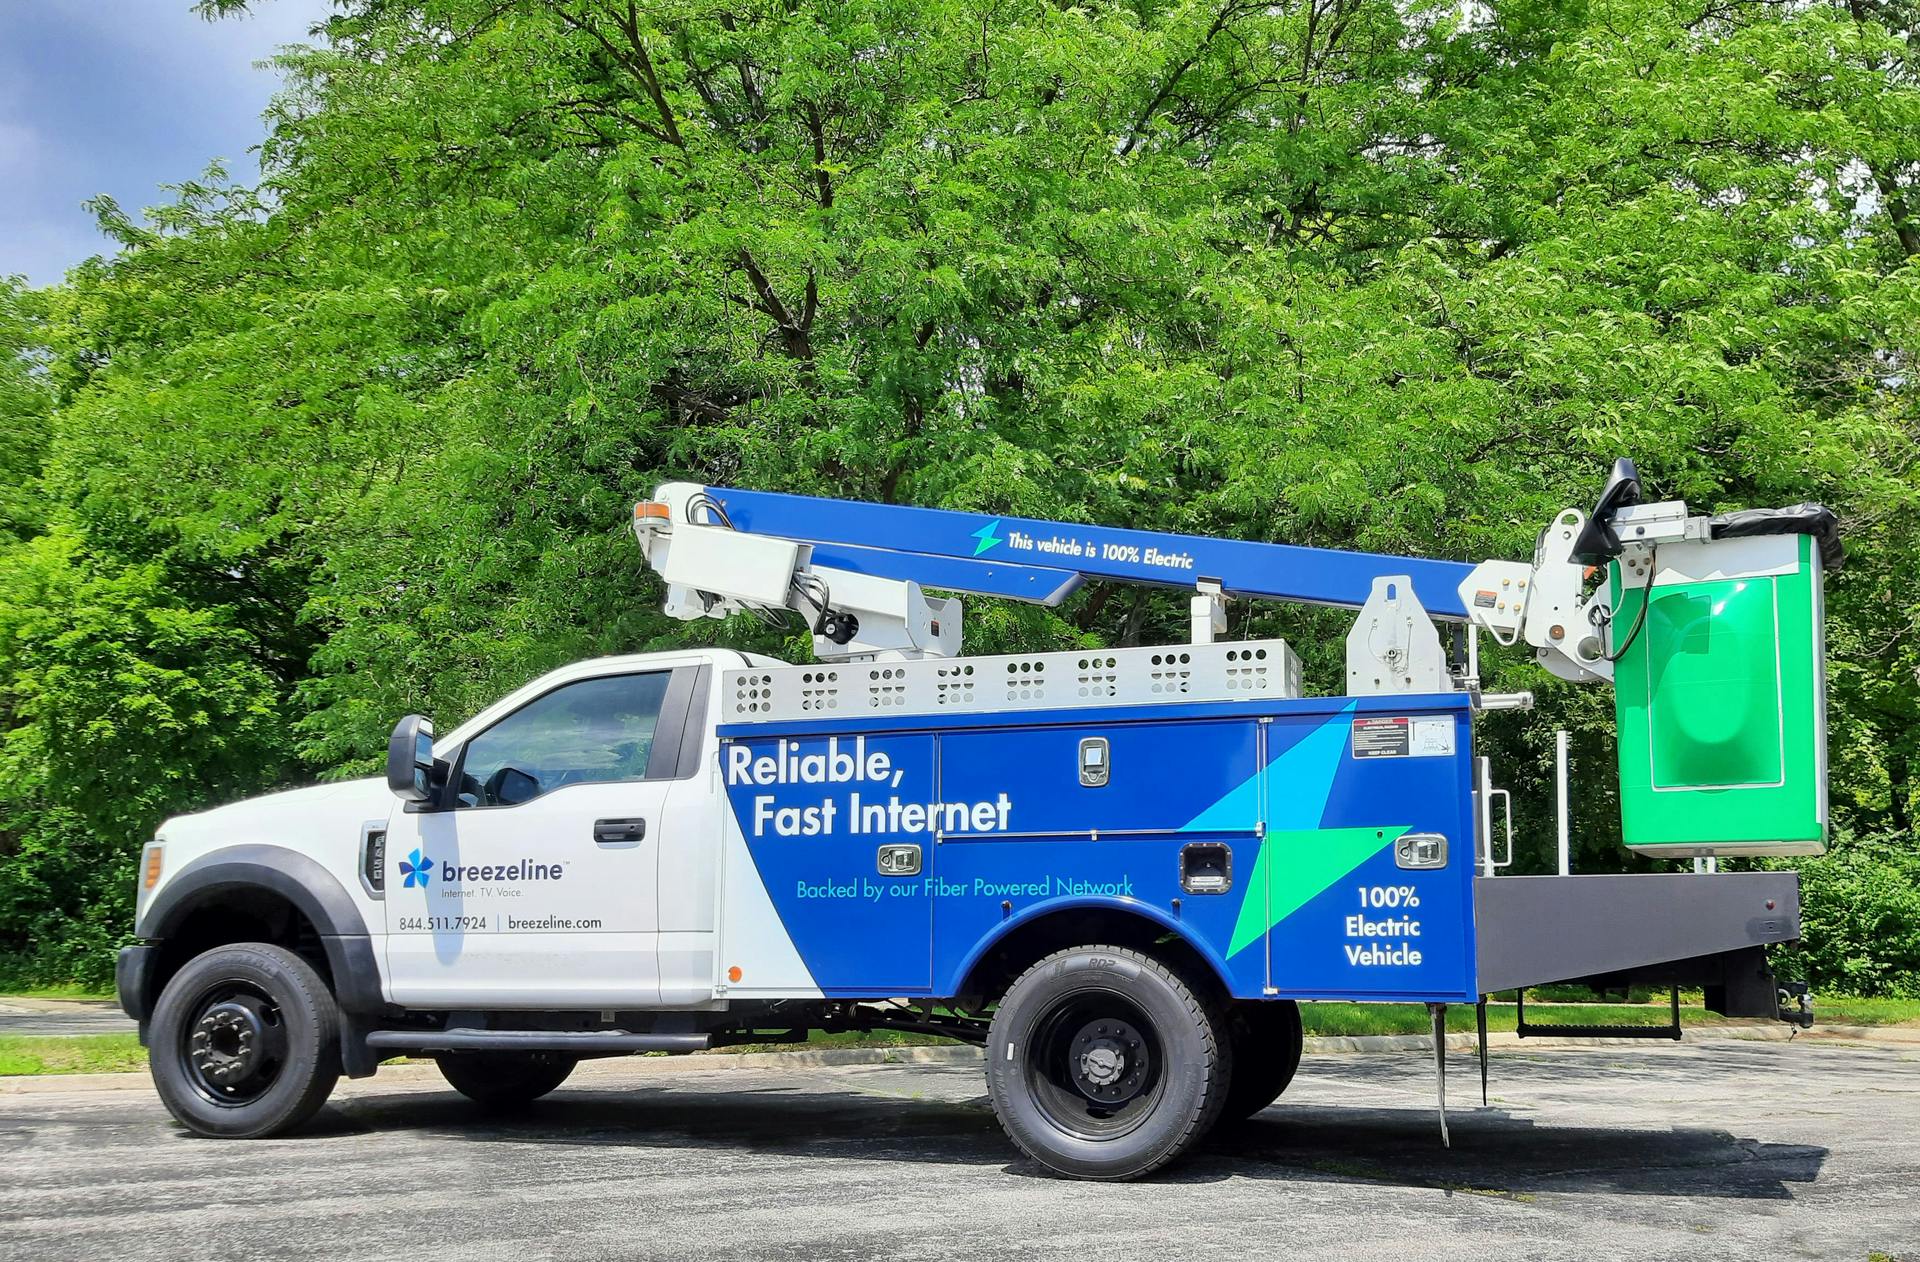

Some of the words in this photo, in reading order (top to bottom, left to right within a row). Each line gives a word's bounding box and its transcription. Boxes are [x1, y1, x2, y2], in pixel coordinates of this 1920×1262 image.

[1009, 532, 1033, 550] This
[1037, 536, 1081, 556] vehicle
[1085, 541, 1096, 557] is
[1102, 544, 1139, 563] 100%
[1143, 549, 1193, 569] Electric
[728, 735, 904, 788] Reliable,
[754, 795, 837, 836] Fast
[851, 793, 1011, 834] Internet
[442, 859, 563, 881] breezeline
[797, 878, 857, 898] Backed
[864, 878, 883, 902] by
[890, 883, 918, 897] our
[924, 877, 967, 896] Fiber
[974, 876, 1050, 897] Powered
[1056, 875, 1133, 896] Network
[1358, 886, 1420, 908] 100%
[399, 916, 486, 930] 844.511.7924
[508, 915, 601, 929] breezeline.com
[1346, 914, 1421, 937] Electric
[1344, 942, 1422, 966] Vehicle
